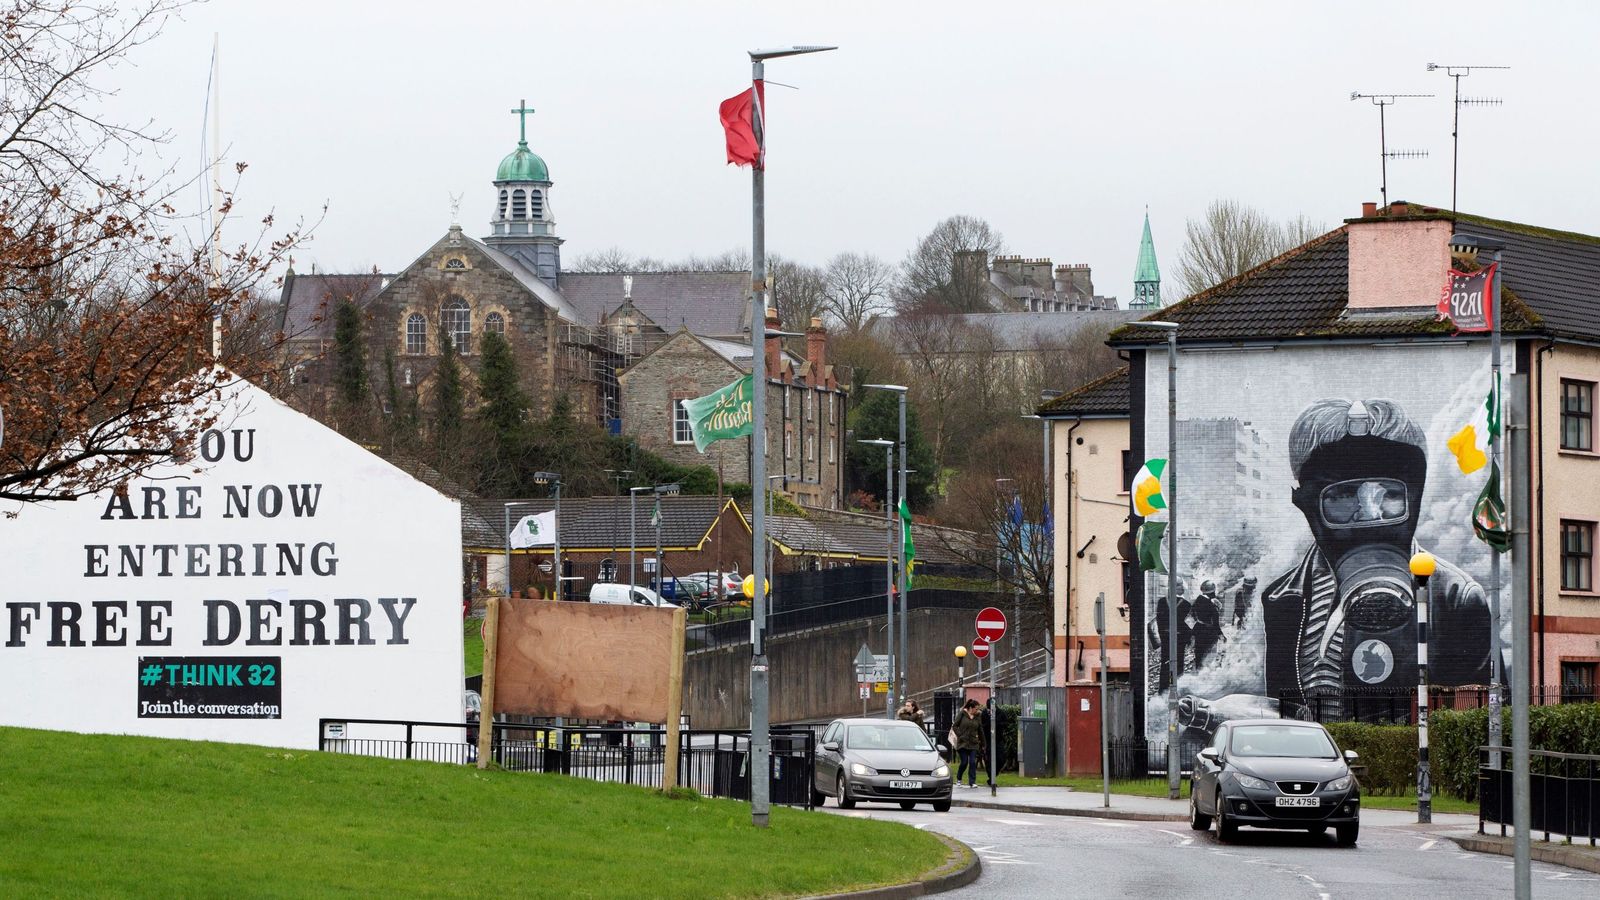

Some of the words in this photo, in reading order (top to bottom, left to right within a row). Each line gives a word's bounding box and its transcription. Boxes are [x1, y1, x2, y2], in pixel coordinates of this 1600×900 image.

[168, 429, 256, 462] OU
[101, 484, 202, 520] ARE
[223, 484, 322, 518] NOW
[84, 542, 339, 577] ENTERING
[5, 601, 173, 647] FREE
[202, 597, 417, 646] DERRY
[141, 664, 244, 686] #THINK
[248, 664, 275, 686] 32
[141, 700, 172, 715] Join
[173, 699, 196, 714] the
[197, 702, 280, 716] conversation
[1278, 798, 1295, 806] OHZ
[1296, 798, 1317, 806] 4796
